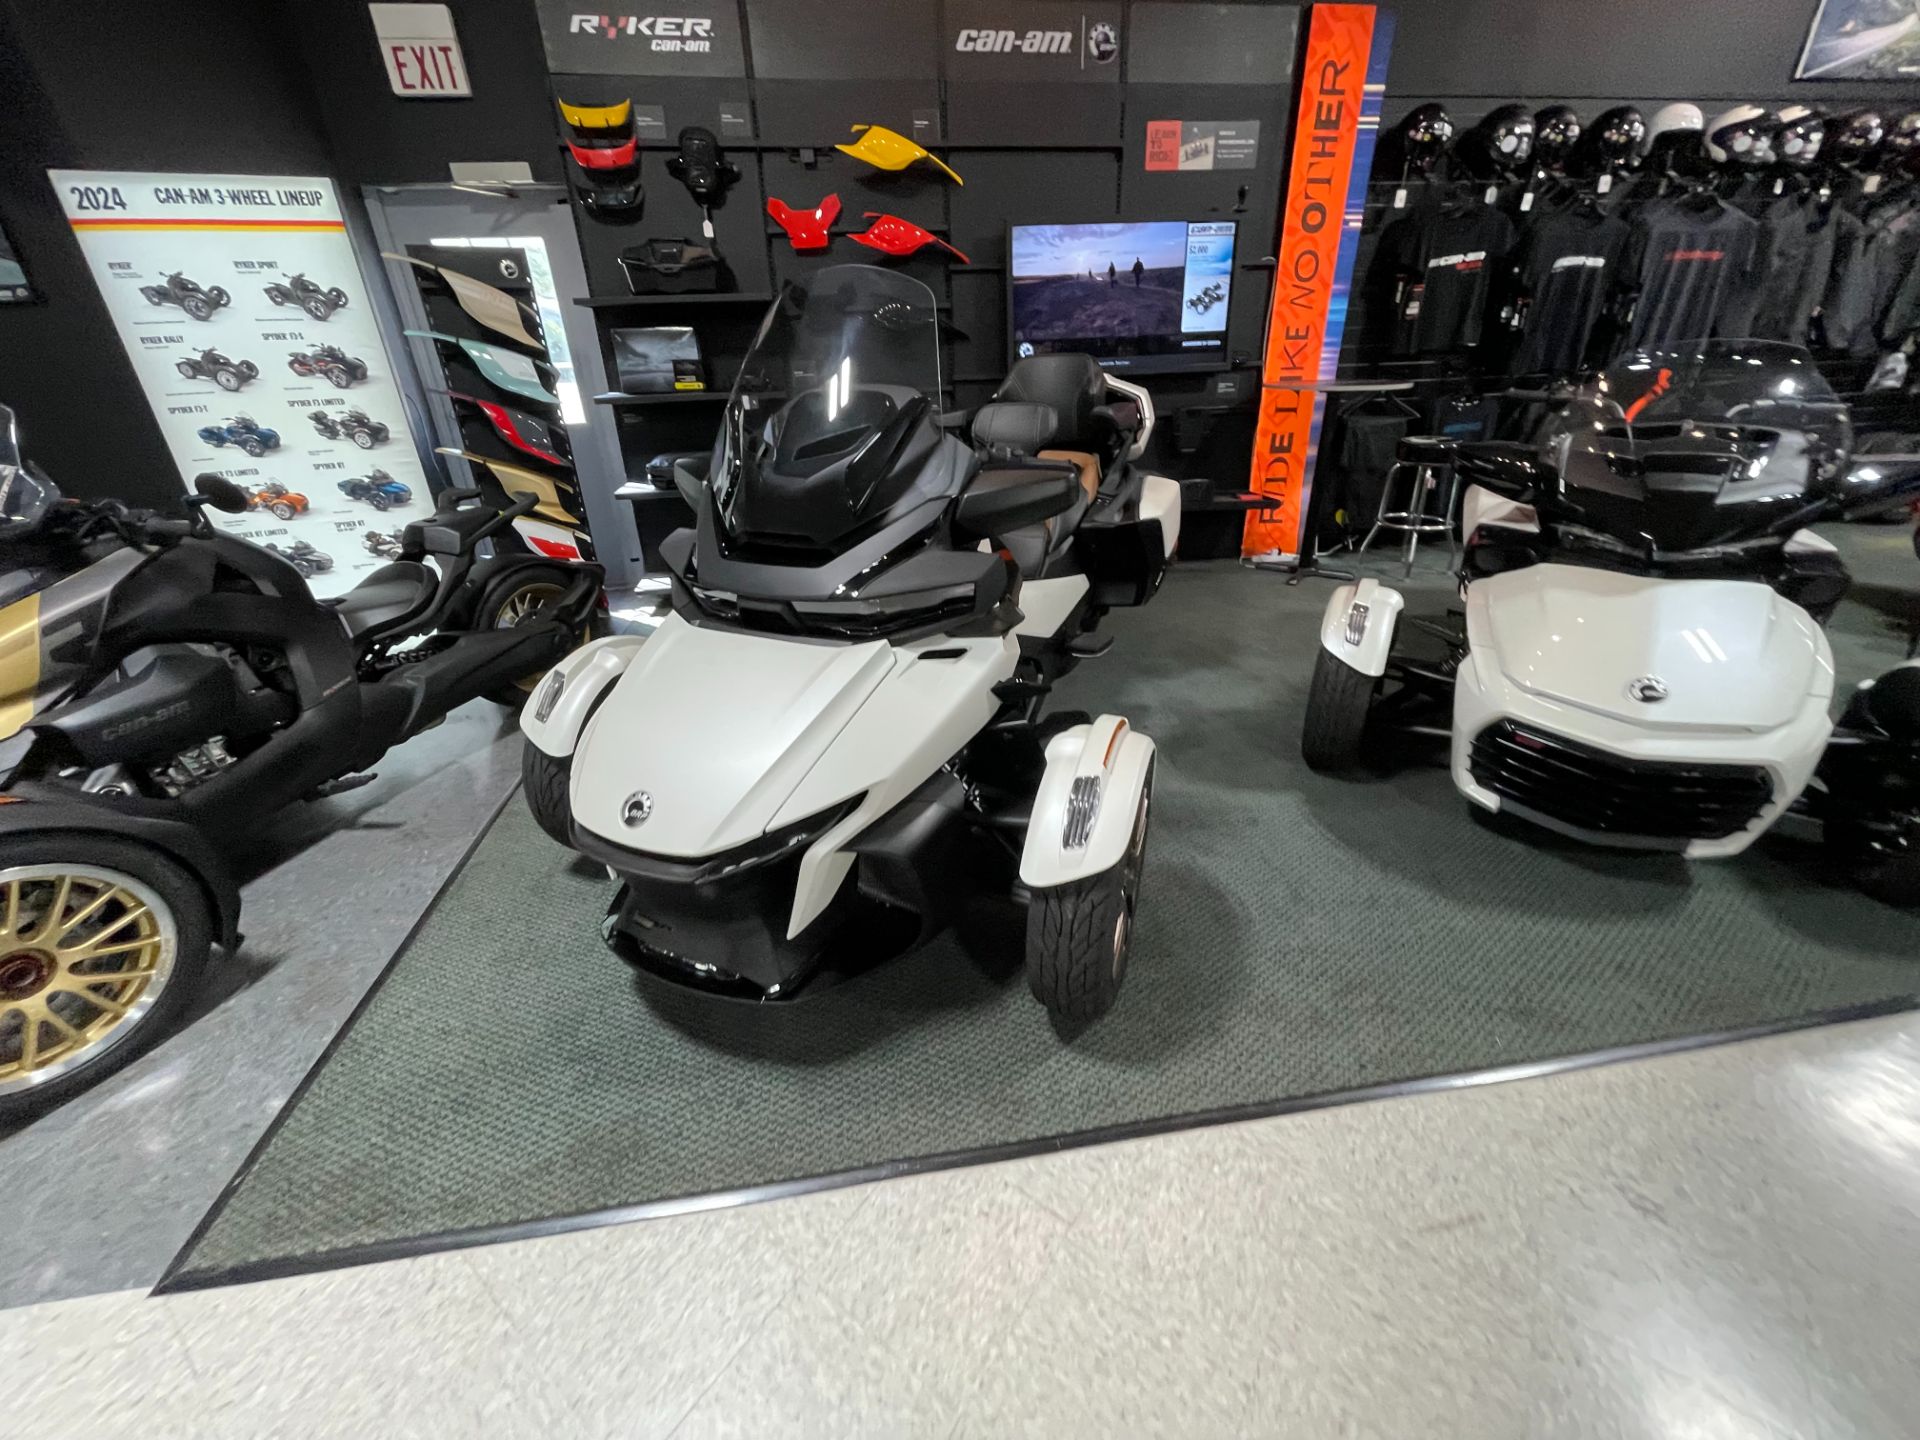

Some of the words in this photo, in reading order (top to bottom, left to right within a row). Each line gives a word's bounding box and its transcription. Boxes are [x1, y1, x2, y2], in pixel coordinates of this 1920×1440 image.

[570, 14, 713, 40] RYKER
[651, 39, 711, 52] can-am
[956, 29, 1072, 53] can-am
[391, 46, 458, 89] EXIT
[1301, 60, 1349, 234] OTHER
[70, 186, 128, 210] 2024
[153, 187, 213, 205] CAN-AM
[214, 188, 276, 206] 3-WHEEL
[276, 190, 324, 207] LINEUP
[1289, 249, 1319, 310] NO
[164, 335, 184, 344] RALLY
[288, 400, 313, 408] SPYDER
[313, 399, 321, 407] F3
[322, 398, 346, 406] LIMITED
[167, 406, 194, 415] SPYDER
[234, 468, 259, 476] LIMITED
[313, 463, 336, 471] SPYDER
[334, 520, 357, 529] SPYDER
[264, 528, 288, 536] LIMITED
